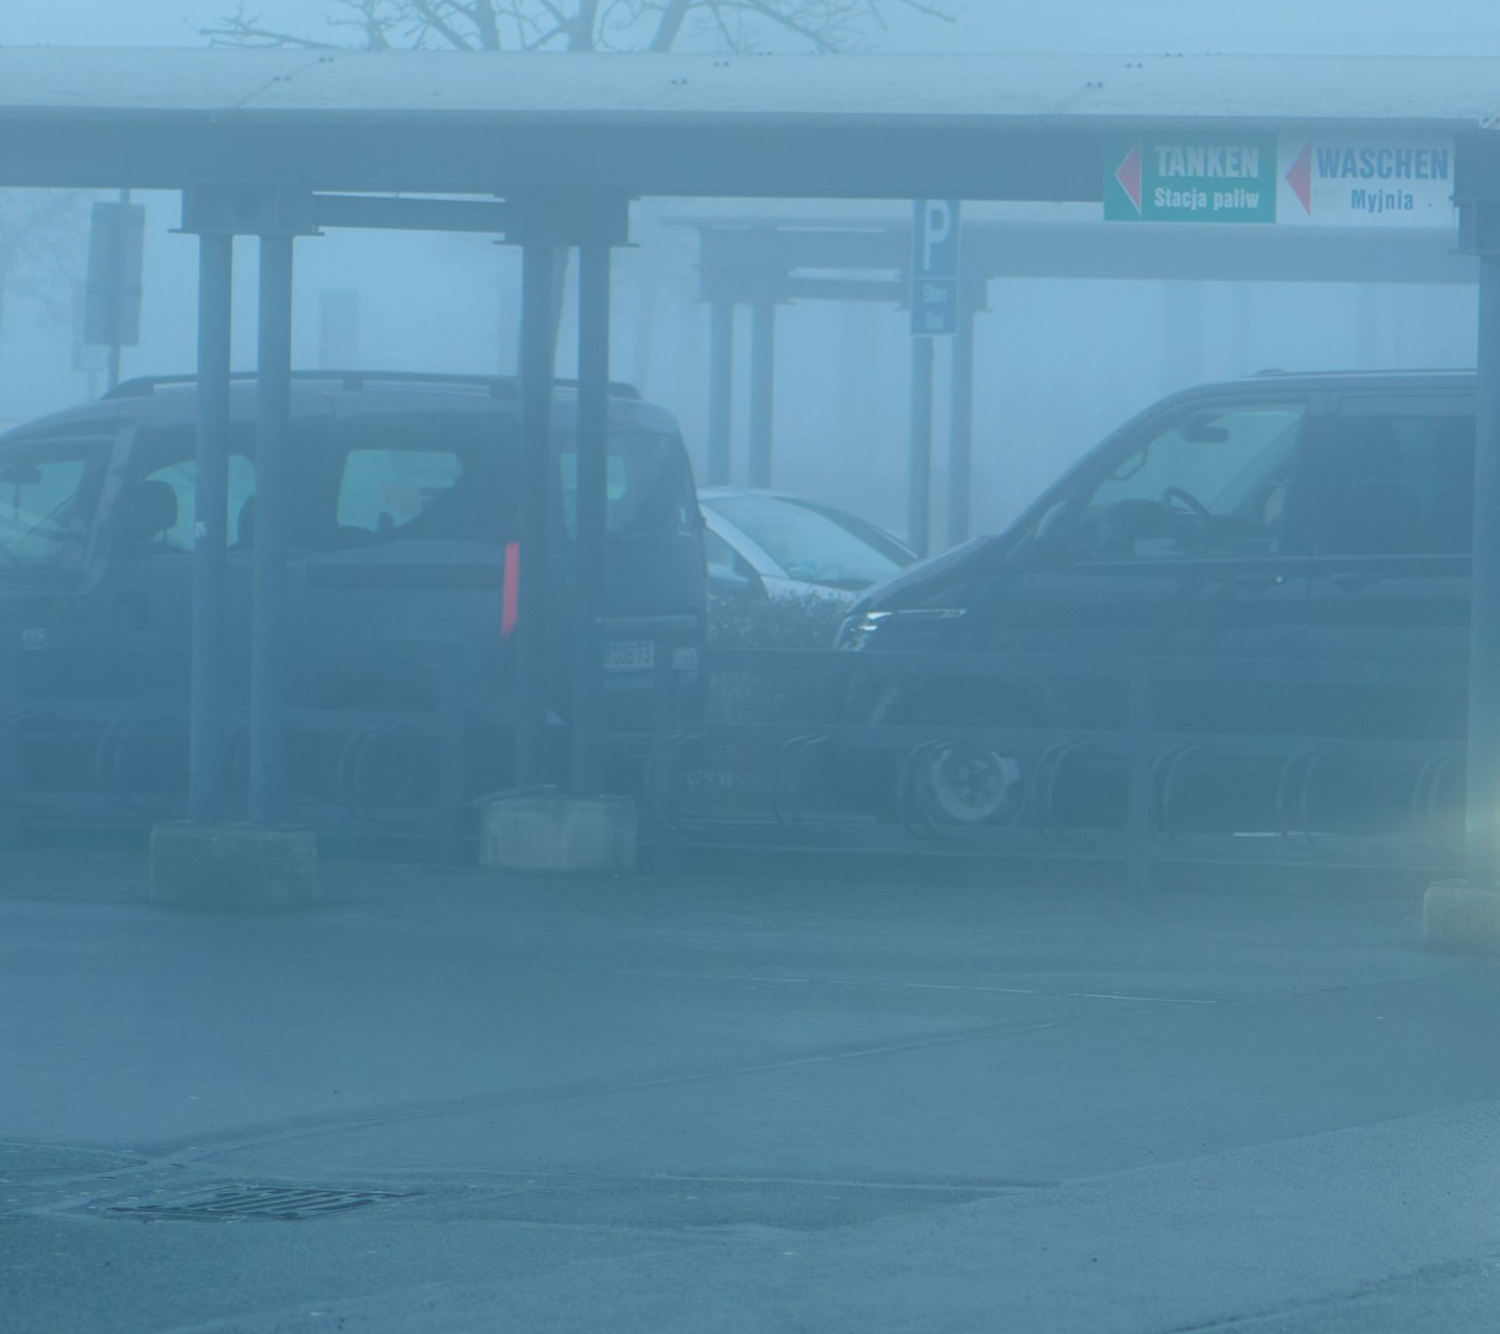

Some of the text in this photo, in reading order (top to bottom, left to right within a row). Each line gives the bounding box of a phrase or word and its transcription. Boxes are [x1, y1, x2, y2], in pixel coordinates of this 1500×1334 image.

[1154, 144, 1260, 180] TANKEN
[1317, 147, 1449, 181] WASCHEN
[1154, 188, 1260, 211] Stacja paliw
[1351, 189, 1414, 213] Myjnia
[922, 199, 951, 271] P
